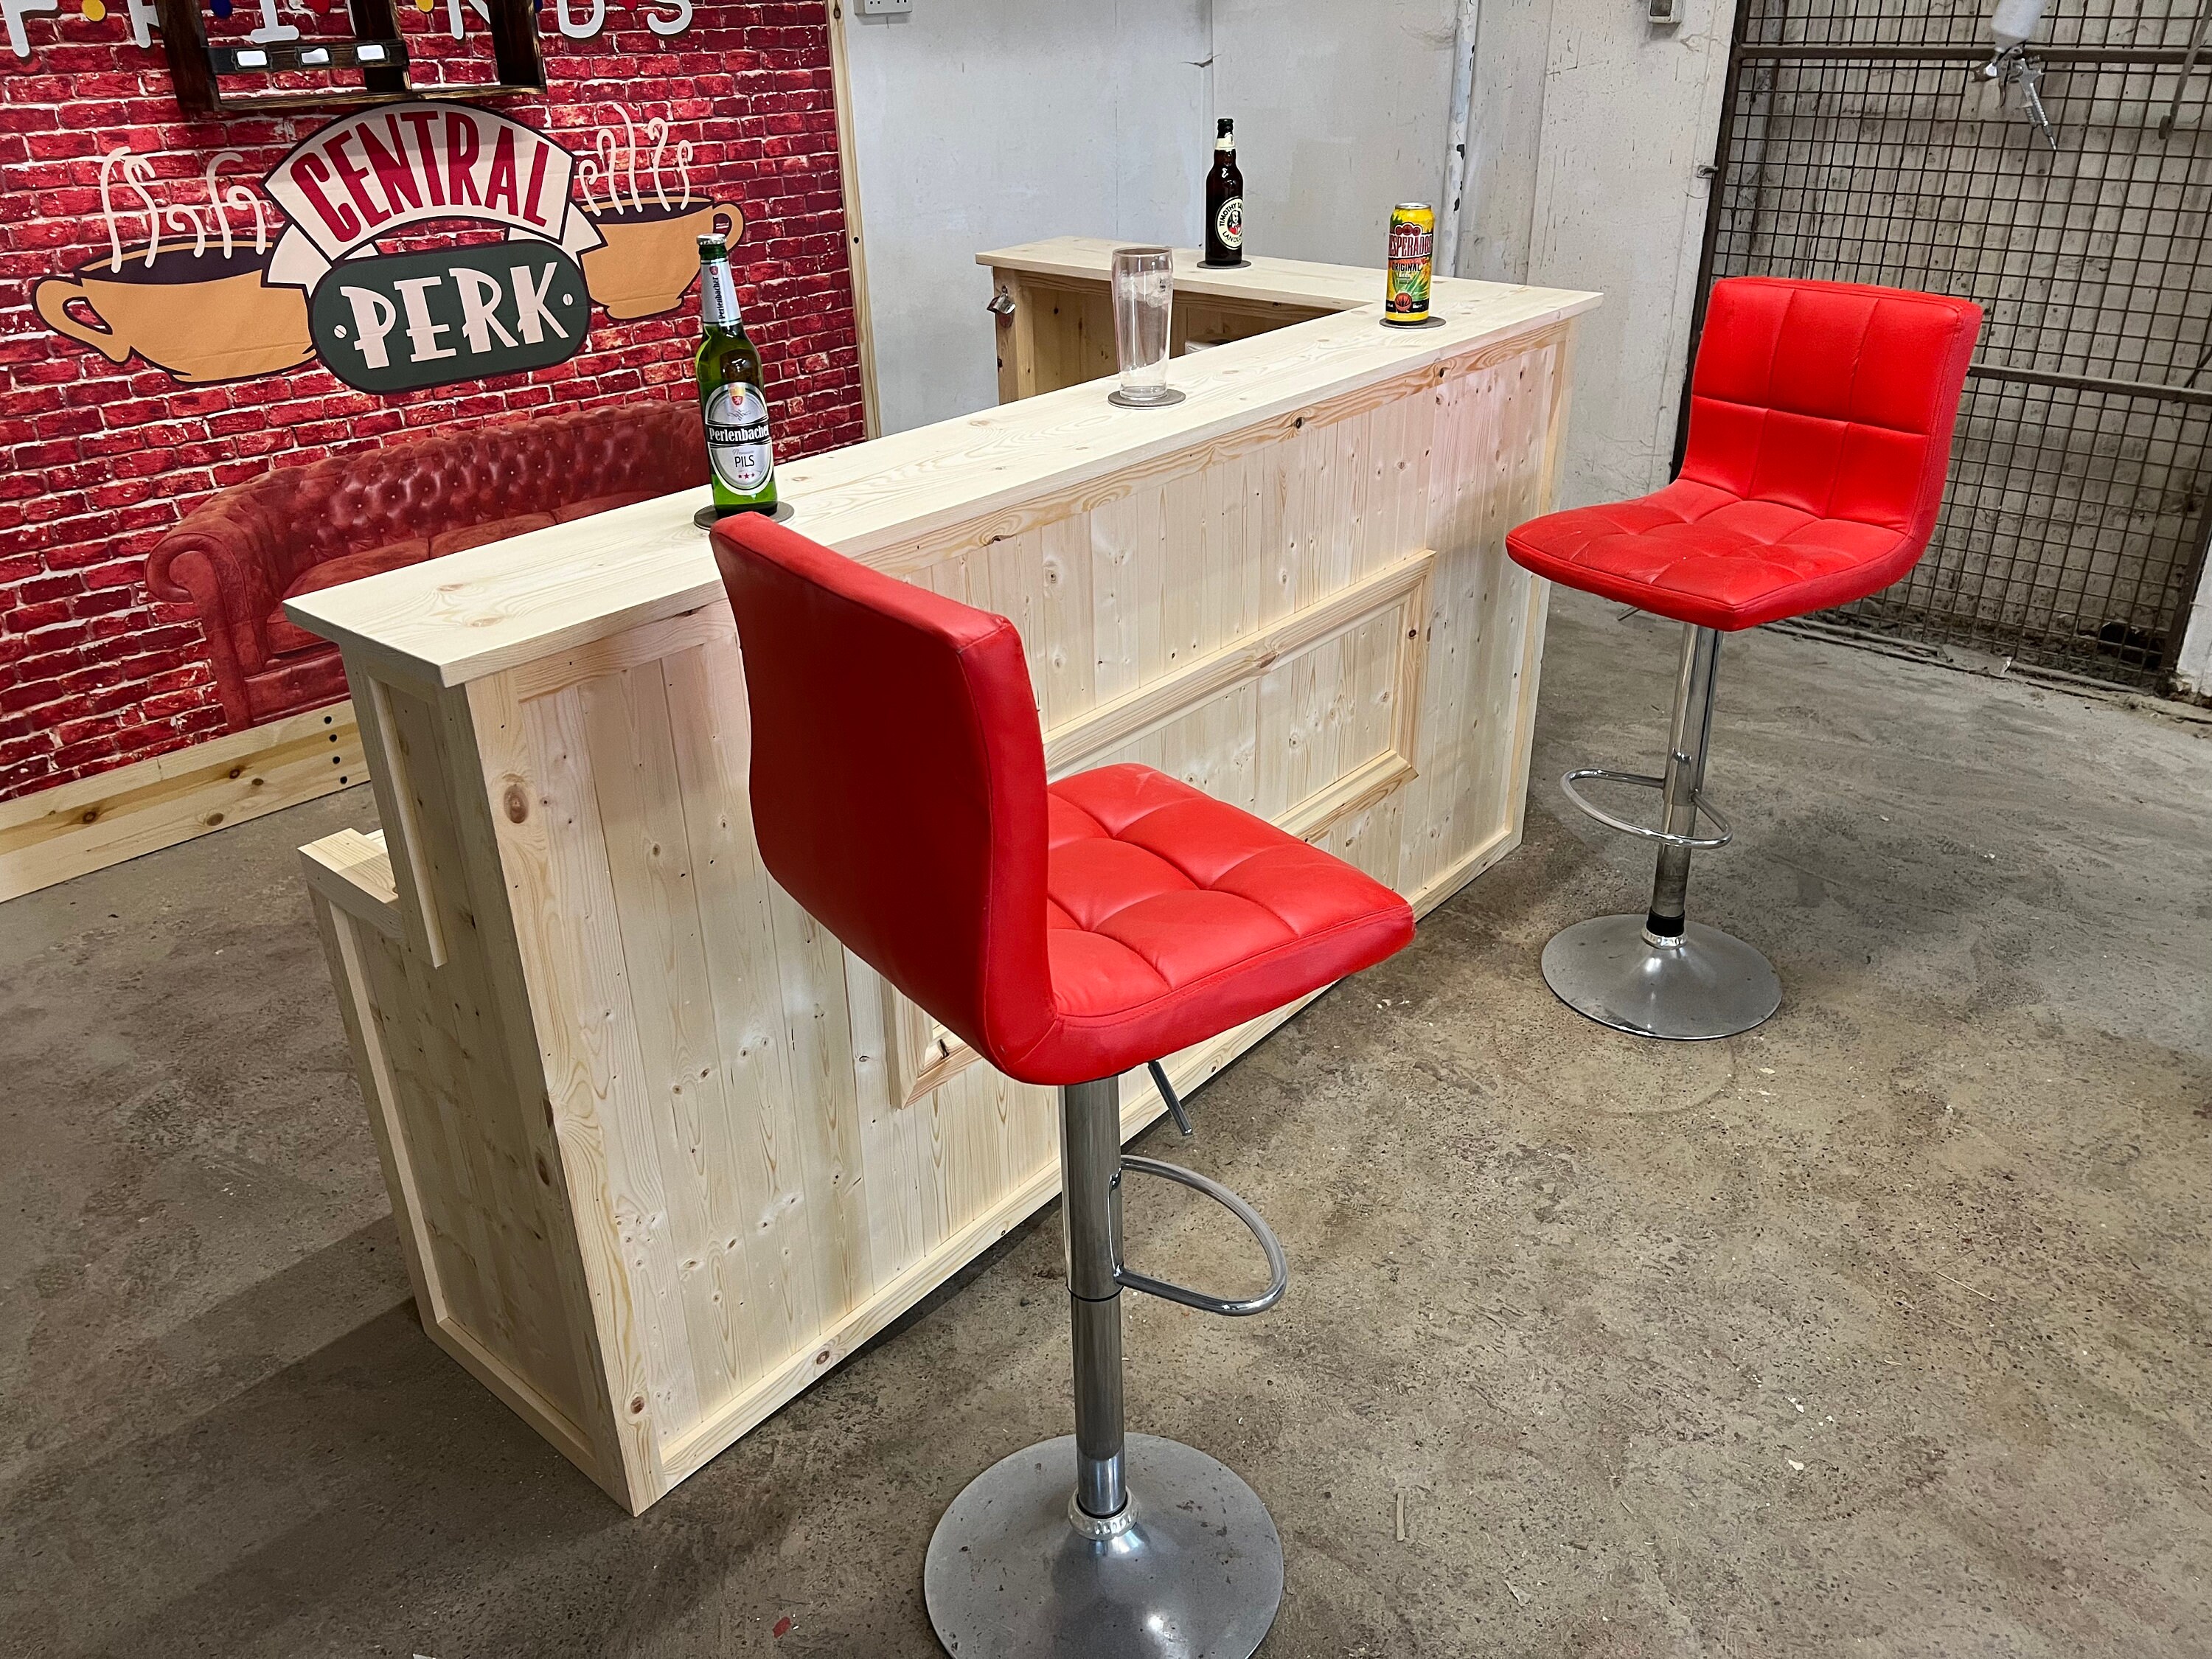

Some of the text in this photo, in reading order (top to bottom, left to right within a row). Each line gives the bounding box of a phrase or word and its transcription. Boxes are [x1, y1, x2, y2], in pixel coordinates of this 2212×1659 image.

[290, 111, 550, 243] CENTRAL
[1219, 203, 1237, 227] TIMOTHY
[1392, 262, 1422, 272] ORIGINAL
[712, 276, 726, 319] Perlenbacher
[339, 262, 569, 369] PERK
[734, 455, 755, 467] PILS
